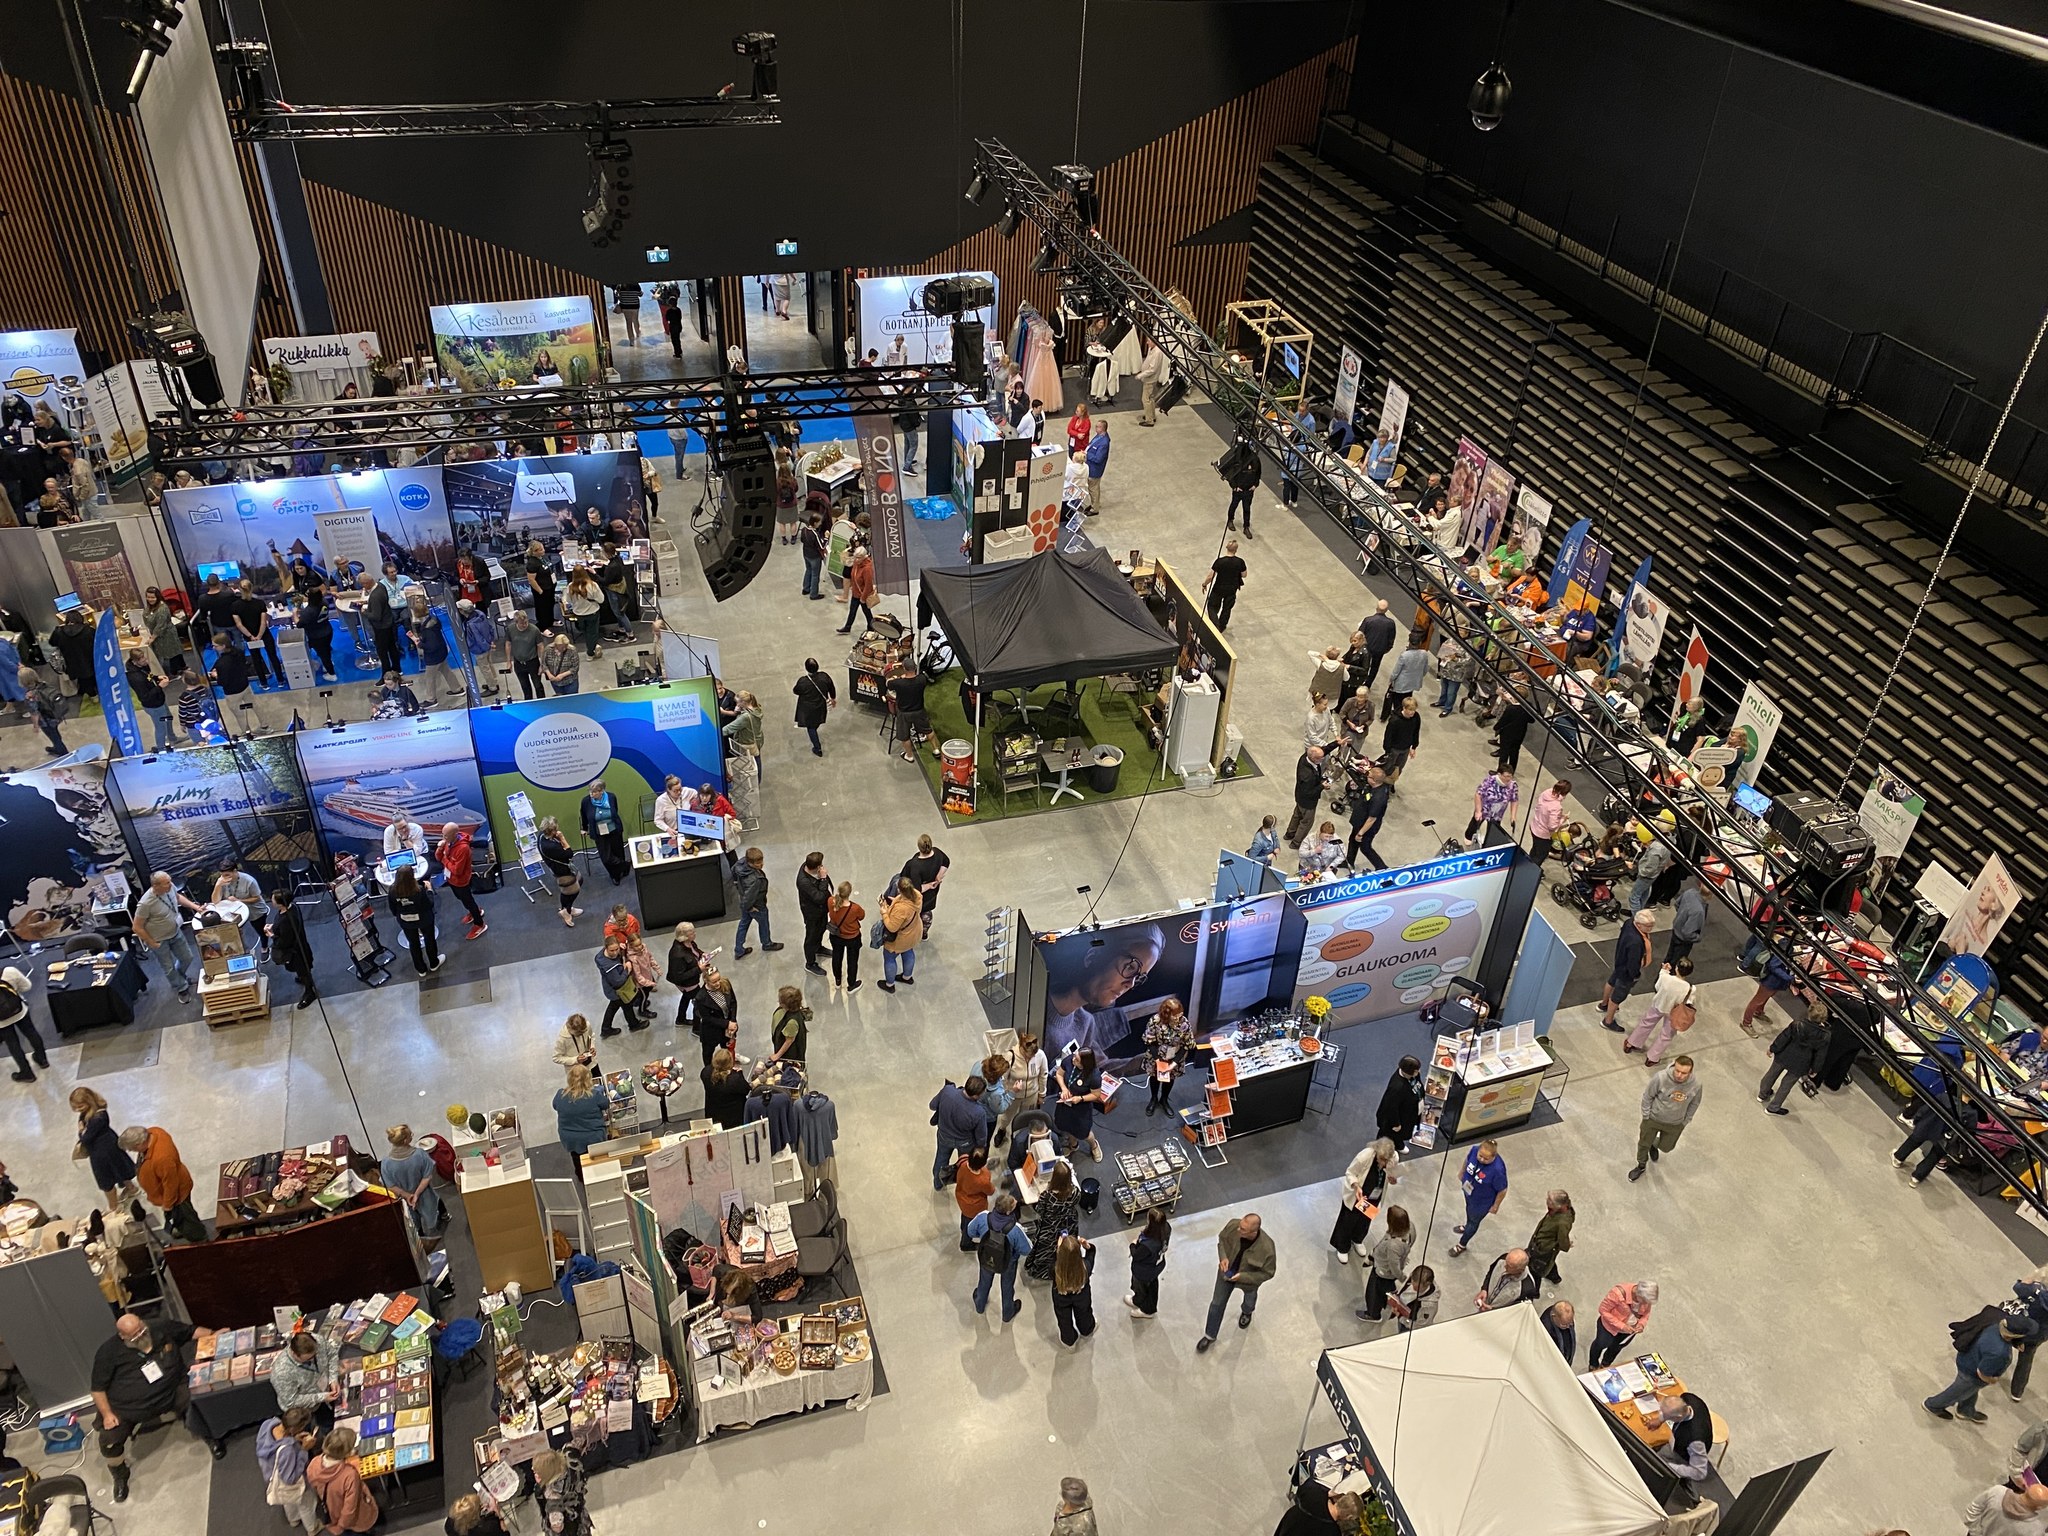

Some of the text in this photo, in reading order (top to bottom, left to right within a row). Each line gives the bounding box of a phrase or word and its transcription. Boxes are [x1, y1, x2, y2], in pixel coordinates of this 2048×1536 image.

[543, 307, 580, 319] kasvattaa
[467, 309, 537, 332] Kesäheinä
[557, 316, 571, 324] iloa
[269, 343, 350, 365] Kukkalikka
[526, 481, 567, 496] SAUNA
[400, 493, 429, 502] KOTKA
[277, 504, 319, 515] OPISTO
[324, 516, 365, 527] DIGITUKI
[657, 700, 695, 711] KYMEN
[1746, 695, 1776, 727] mieli
[658, 708, 696, 719] LAAKSON
[372, 733, 396, 741] VIKING
[542, 726, 578, 737] POLKUJA
[523, 731, 599, 748] UUDEN OPPIMISEEN
[1874, 797, 1906, 826] KAKSPY
[1336, 947, 1437, 978] GLAUKOOMA
[1376, 1481, 1406, 1536] KOT
